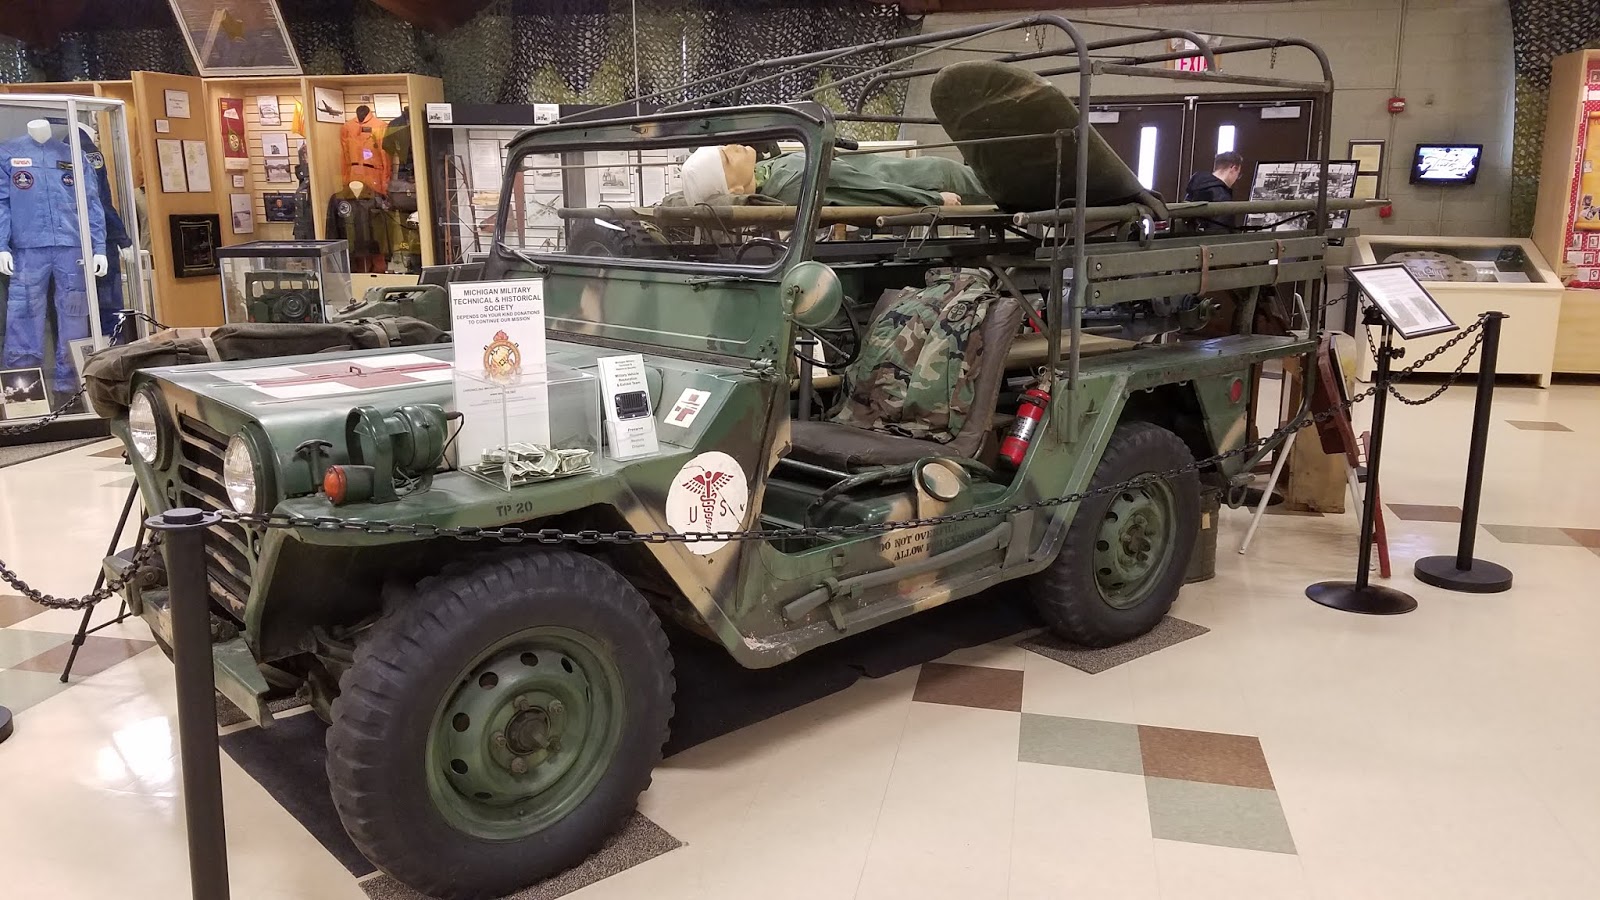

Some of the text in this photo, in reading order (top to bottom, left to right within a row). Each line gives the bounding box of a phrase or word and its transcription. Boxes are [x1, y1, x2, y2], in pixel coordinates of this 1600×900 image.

[463, 286, 531, 296] MICHIGAN MILITARY
[453, 297, 493, 305] TECHNICAL
[501, 294, 542, 302] HISTORICAL
[484, 304, 514, 312] SOCIETY
[496, 501, 533, 517] TP 20
[689, 499, 727, 523] U S
[894, 535, 912, 548] NOT
[893, 544, 922, 561] ALLOW
